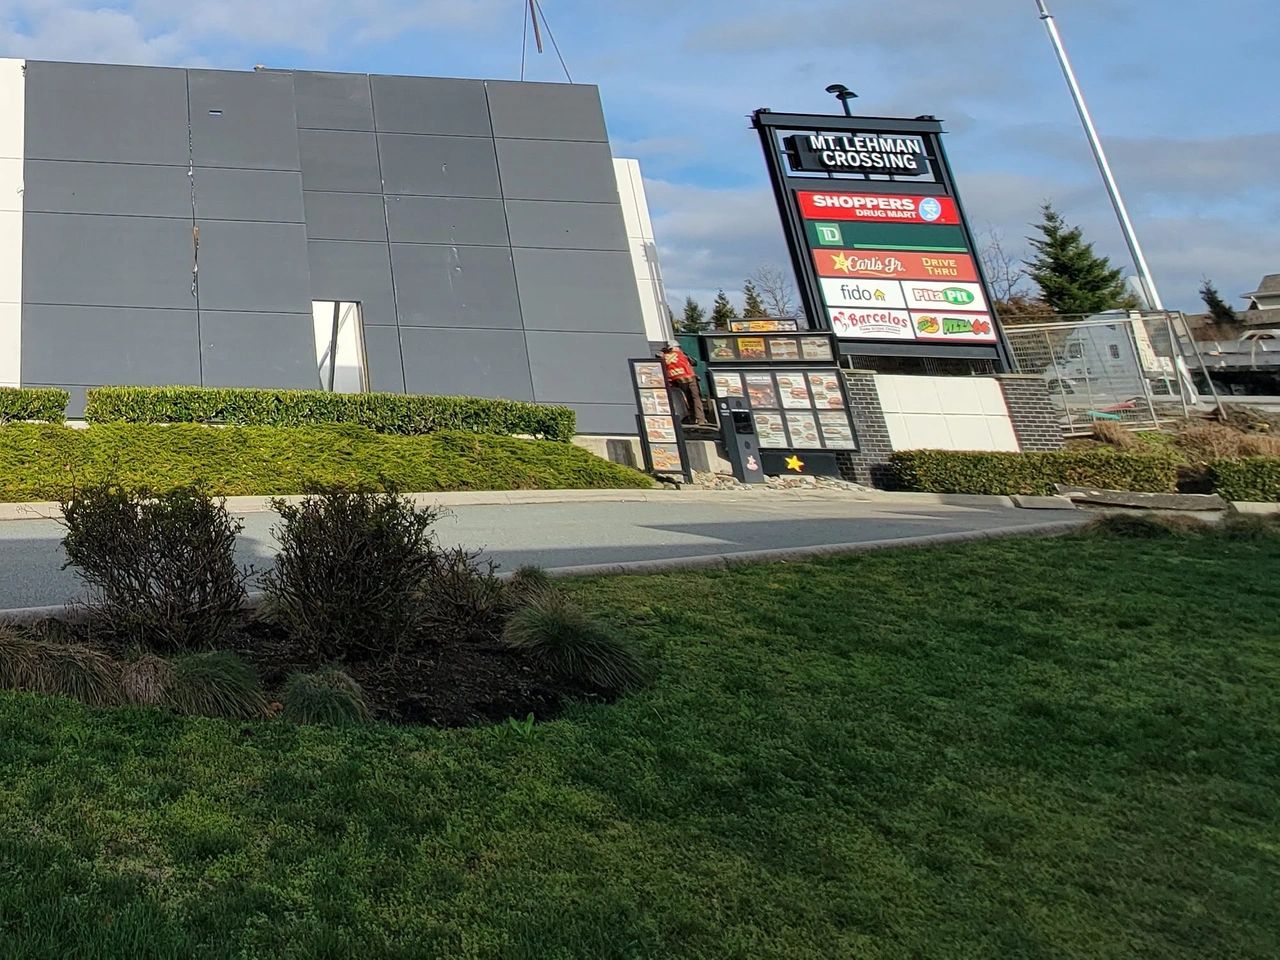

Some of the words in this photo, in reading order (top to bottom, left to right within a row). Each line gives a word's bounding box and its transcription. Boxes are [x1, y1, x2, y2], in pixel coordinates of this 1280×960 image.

[810, 136, 840, 150] MT.
[843, 137, 921, 154] LEHMAN
[823, 151, 918, 169] CROSSING
[813, 195, 915, 210] SHOPPERS
[856, 210, 886, 218] DRUG
[888, 211, 917, 219] MART
[820, 227, 840, 241] TD
[847, 255, 883, 272] Carl's
[884, 256, 906, 272] Jr.
[922, 257, 958, 267] DRIVE
[925, 267, 958, 276] THRU
[840, 284, 872, 301] fido
[912, 288, 944, 302] Pita
[945, 289, 969, 303] Pit
[847, 311, 908, 328] Barcelos
